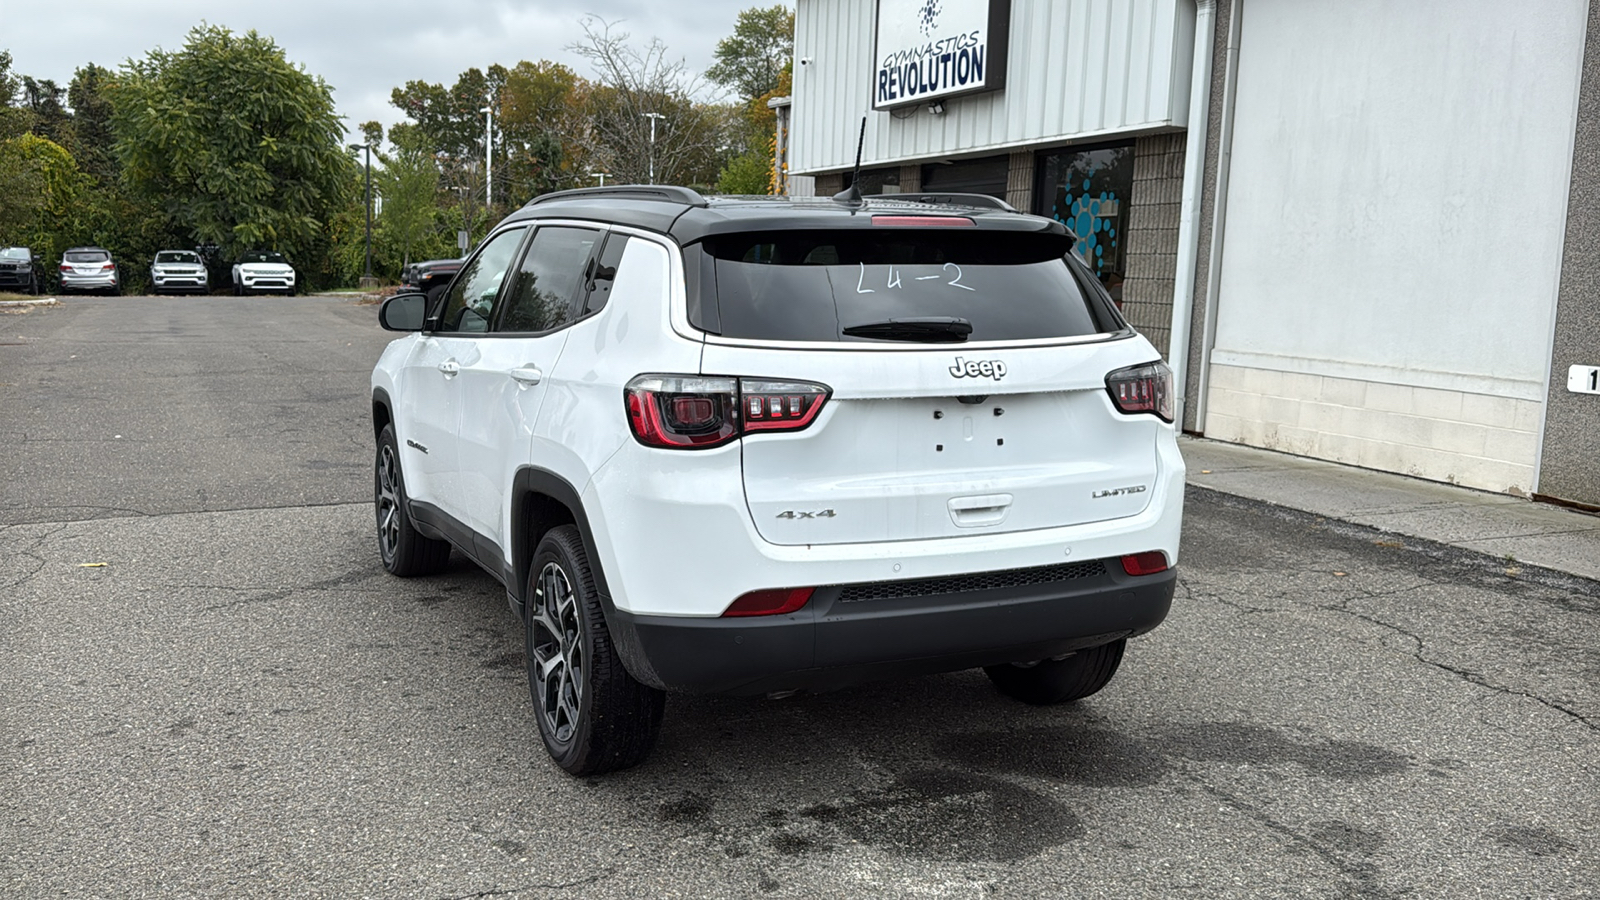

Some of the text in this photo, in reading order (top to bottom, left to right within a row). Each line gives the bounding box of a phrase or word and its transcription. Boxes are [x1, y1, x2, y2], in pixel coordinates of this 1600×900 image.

[883, 30, 980, 71] GYMNASTICS
[878, 44, 985, 102] REVOLUTION
[948, 356, 1008, 381] Jeep
[1091, 484, 1147, 499] LIMITED
[775, 509, 837, 520] 4x4
